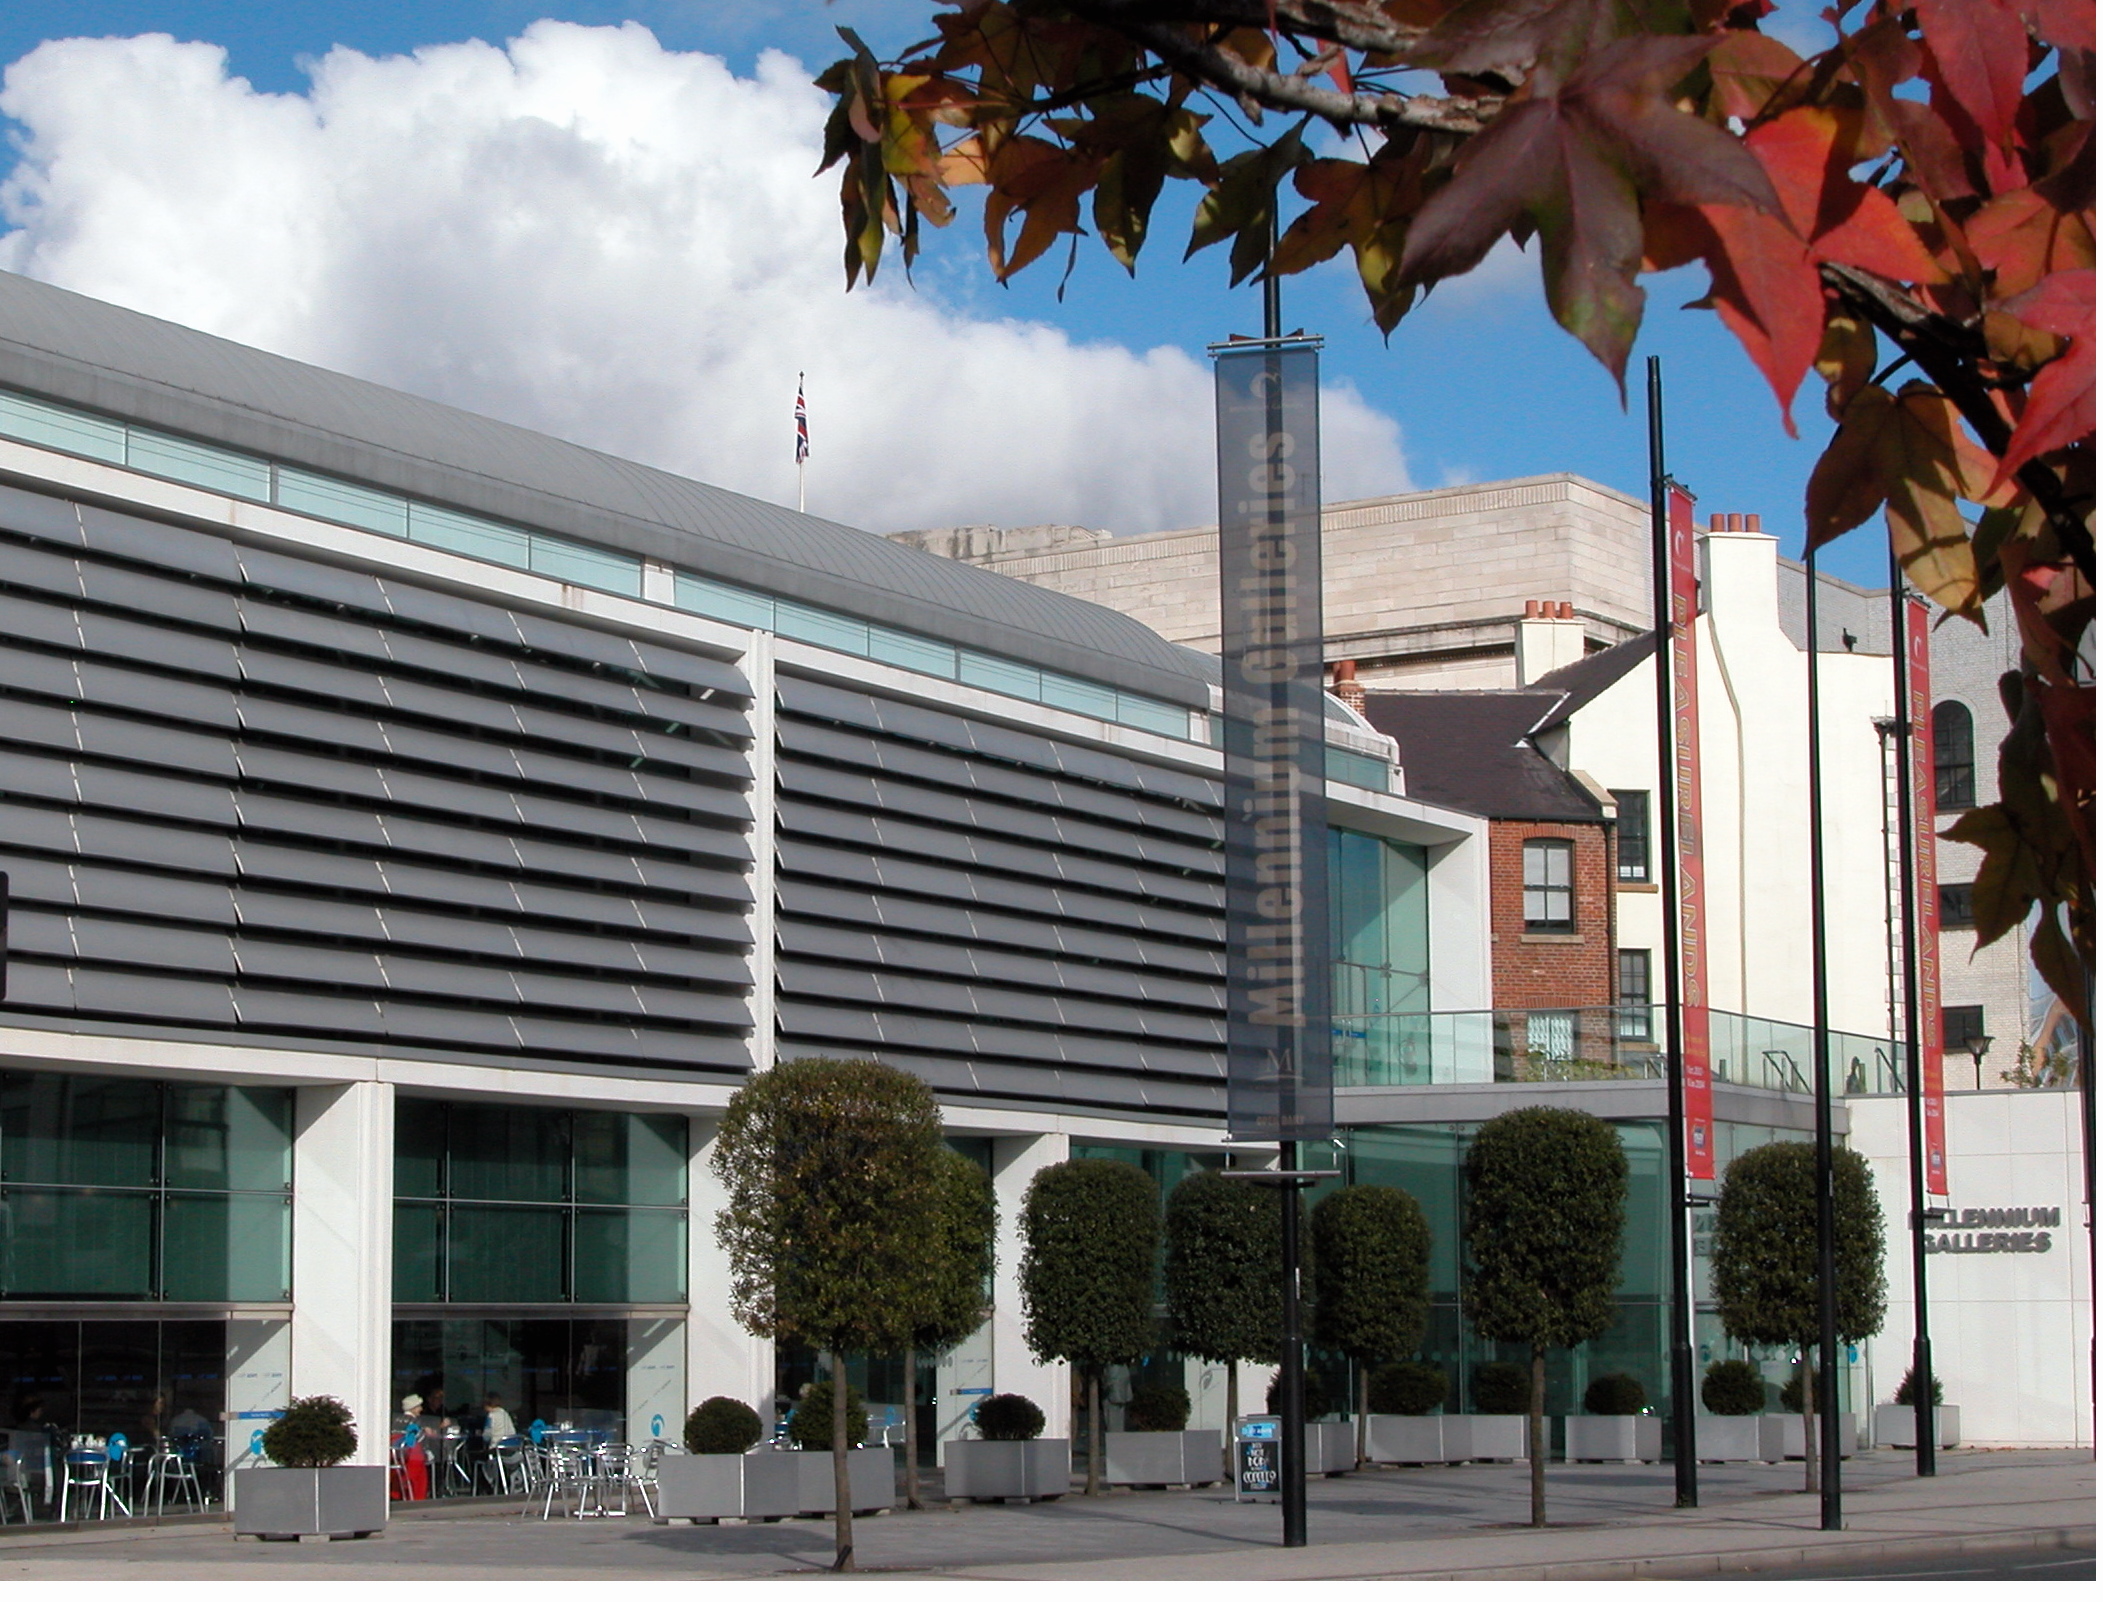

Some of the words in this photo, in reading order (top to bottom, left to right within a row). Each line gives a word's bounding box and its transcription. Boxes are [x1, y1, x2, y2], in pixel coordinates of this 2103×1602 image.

[1238, 430, 1298, 684] Galleries
[1243, 708, 1306, 1027] Millennium
[1673, 593, 1700, 1008] PLEASURELANDS
